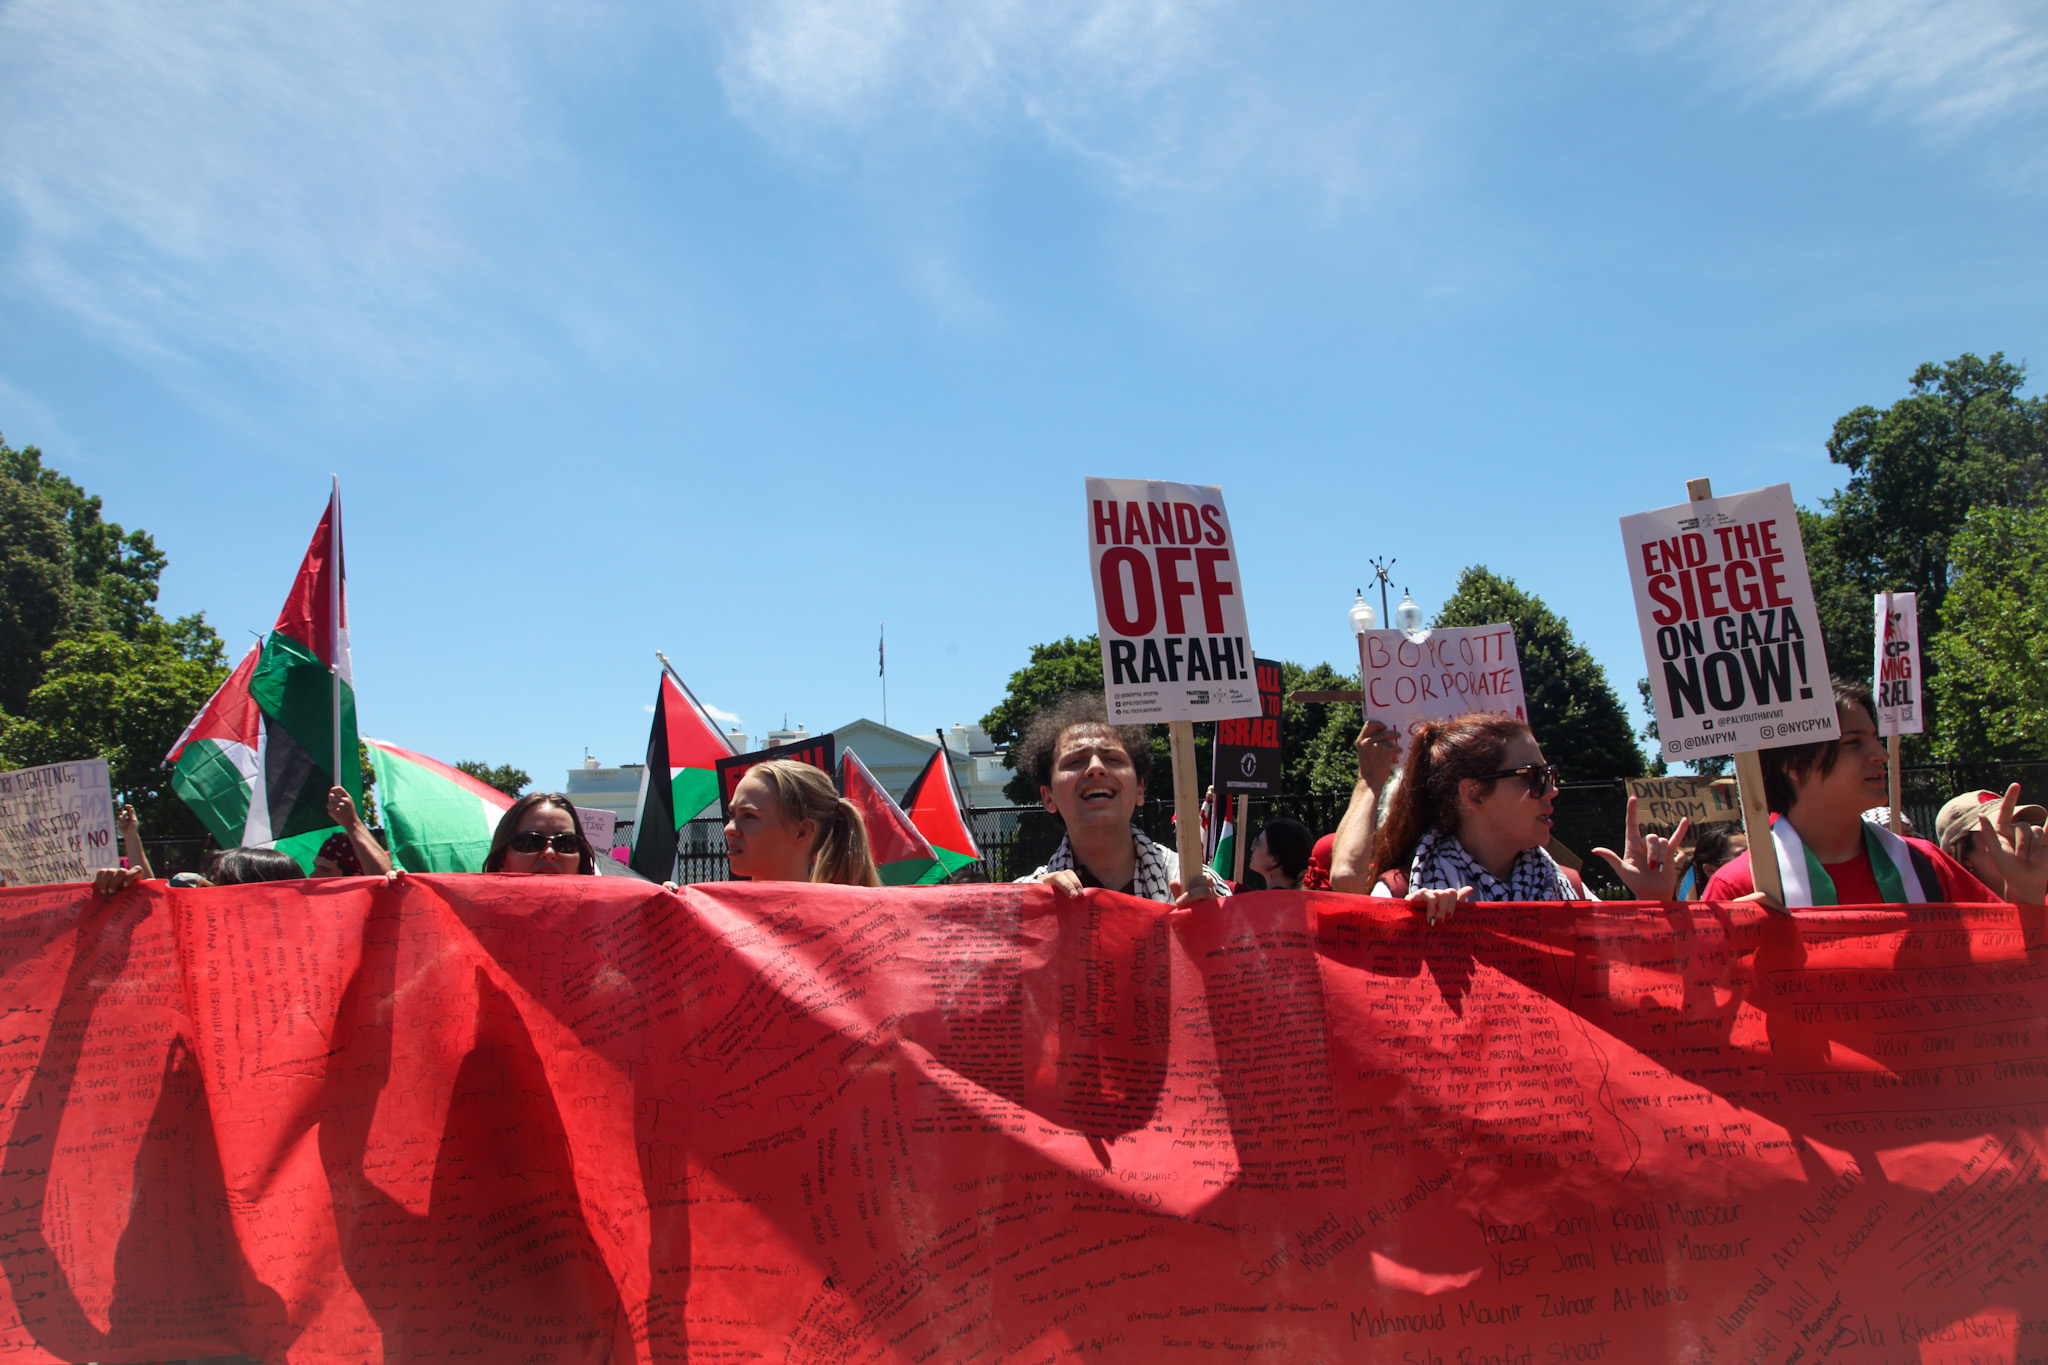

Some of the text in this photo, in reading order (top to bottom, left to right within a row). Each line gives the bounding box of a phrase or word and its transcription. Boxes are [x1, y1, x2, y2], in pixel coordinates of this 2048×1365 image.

[1093, 500, 1226, 546] HANDS
[1641, 519, 1783, 577] END THE
[1100, 546, 1233, 637] OFF
[1647, 554, 1794, 626] SIEGE
[1368, 631, 1511, 669] BOYCOTT
[1656, 606, 1805, 661] ON GAZA
[1884, 641, 1910, 657] OP
[1110, 637, 1248, 684] RAFAH!
[1662, 639, 1814, 719] NOW!
[1268, 696, 1280, 716] TO
[1370, 667, 1514, 708] CORPORATE
[1879, 680, 1913, 707] RAEL
[1219, 718, 1279, 748] ISRAEL
[1684, 717, 1831, 750] @DMVPYM @NYCPYM
[1718, 709, 1784, 727] @PALYOUTHMVMT
[1632, 781, 1698, 798] DIVEST
[51, 811, 80, 835] STOP
[1650, 800, 1708, 818] FROM
[68, 835, 82, 853] BE
[88, 829, 109, 849] NO
[1130, 938, 1147, 984] Obaid
[1766, 976, 1812, 996] JAZAR
[1050, 983, 1077, 1034] Sama
[1794, 1006, 1822, 1024] DAN
[1833, 1006, 1860, 1021] ABU
[1872, 1038, 1910, 1056] AYYAD
[1472, 1200, 1744, 1246] Yazan Jamil Khalil Mansour
[1240, 1210, 1343, 1287] Samir Ahmed
[1490, 1232, 1752, 1283] Yusr Jamil Khalil Mansour
[1715, 1267, 1777, 1337] Hammad
[1772, 1231, 1807, 1272] Abu
[1350, 1302, 1447, 1341] Mahmoud
[1743, 1327, 1782, 1365] bdel
[1776, 1279, 1820, 1331] Jalil
[1800, 1291, 1844, 1343] Mansour
[1837, 1313, 1886, 1349] Sila
[1897, 1312, 1957, 1345] Khaled
[1962, 1315, 2006, 1340] Nabil
[519, 1353, 558, 1365] SAEED
[1546, 1331, 1612, 1363] Shaat
